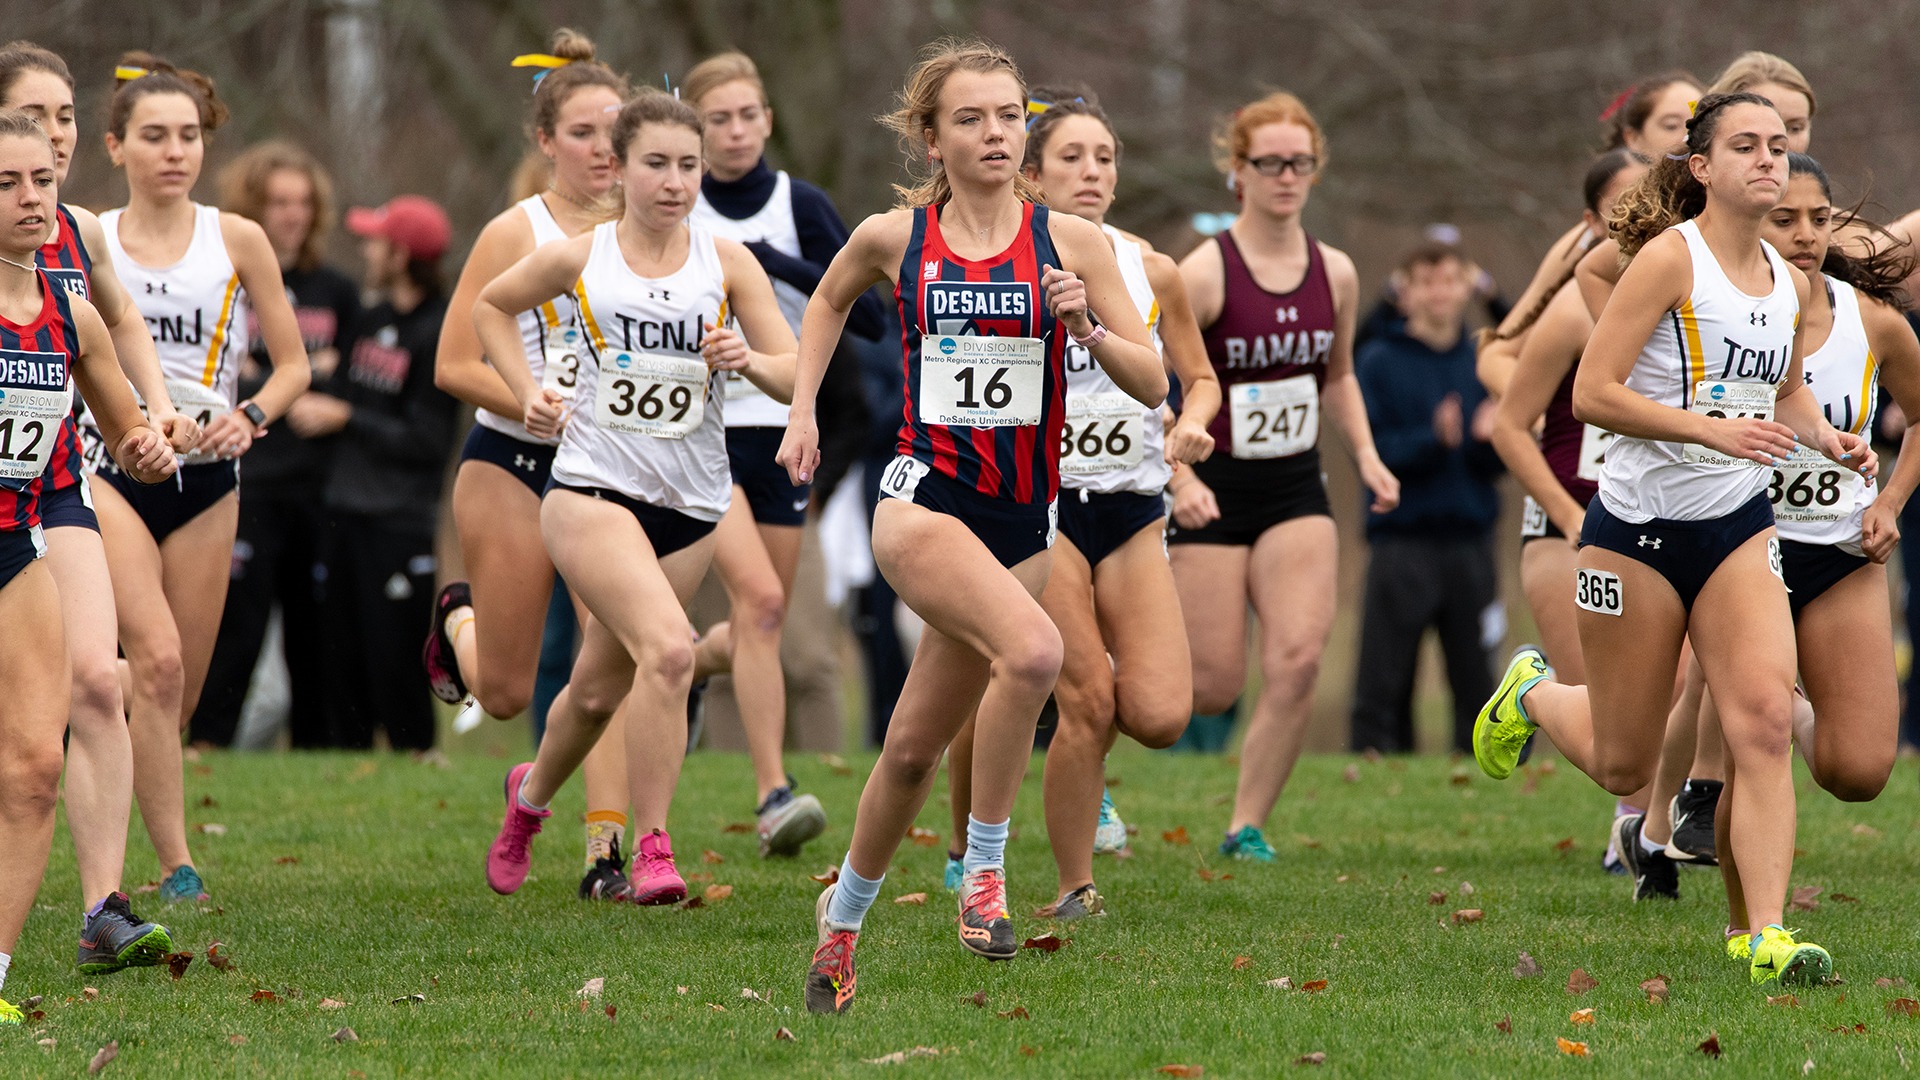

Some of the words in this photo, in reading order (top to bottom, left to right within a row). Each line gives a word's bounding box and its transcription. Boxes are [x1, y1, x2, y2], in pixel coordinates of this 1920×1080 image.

[932, 289, 1026, 316] DESALES
[615, 311, 704, 354] TCNJ
[963, 342, 1016, 352] DIVISION
[1019, 344, 1030, 353] III
[637, 359, 685, 373] DIVISION
[924, 355, 945, 363] Metro
[946, 357, 978, 365] Regional
[991, 358, 1043, 367] Championship
[1720, 336, 1788, 385] TCNJ
[601, 367, 620, 376] Metro
[621, 371, 650, 381] Regional
[954, 366, 1013, 410] 16
[1730, 388, 1763, 399] DIVISION
[9, 394, 51, 406] DIVISION
[608, 379, 692, 422] 369
[1695, 399, 1713, 407] Metro
[20, 410, 30, 418] XC
[939, 415, 977, 424] DeSales
[979, 416, 1024, 425] University
[609, 422, 643, 433] DeSales
[645, 427, 687, 439] University
[1247, 403, 1309, 444] 247
[1698, 455, 1731, 466] DeSales
[886, 455, 915, 492] 16
[1795, 513, 1839, 522] University
[1578, 571, 1620, 611] 365
